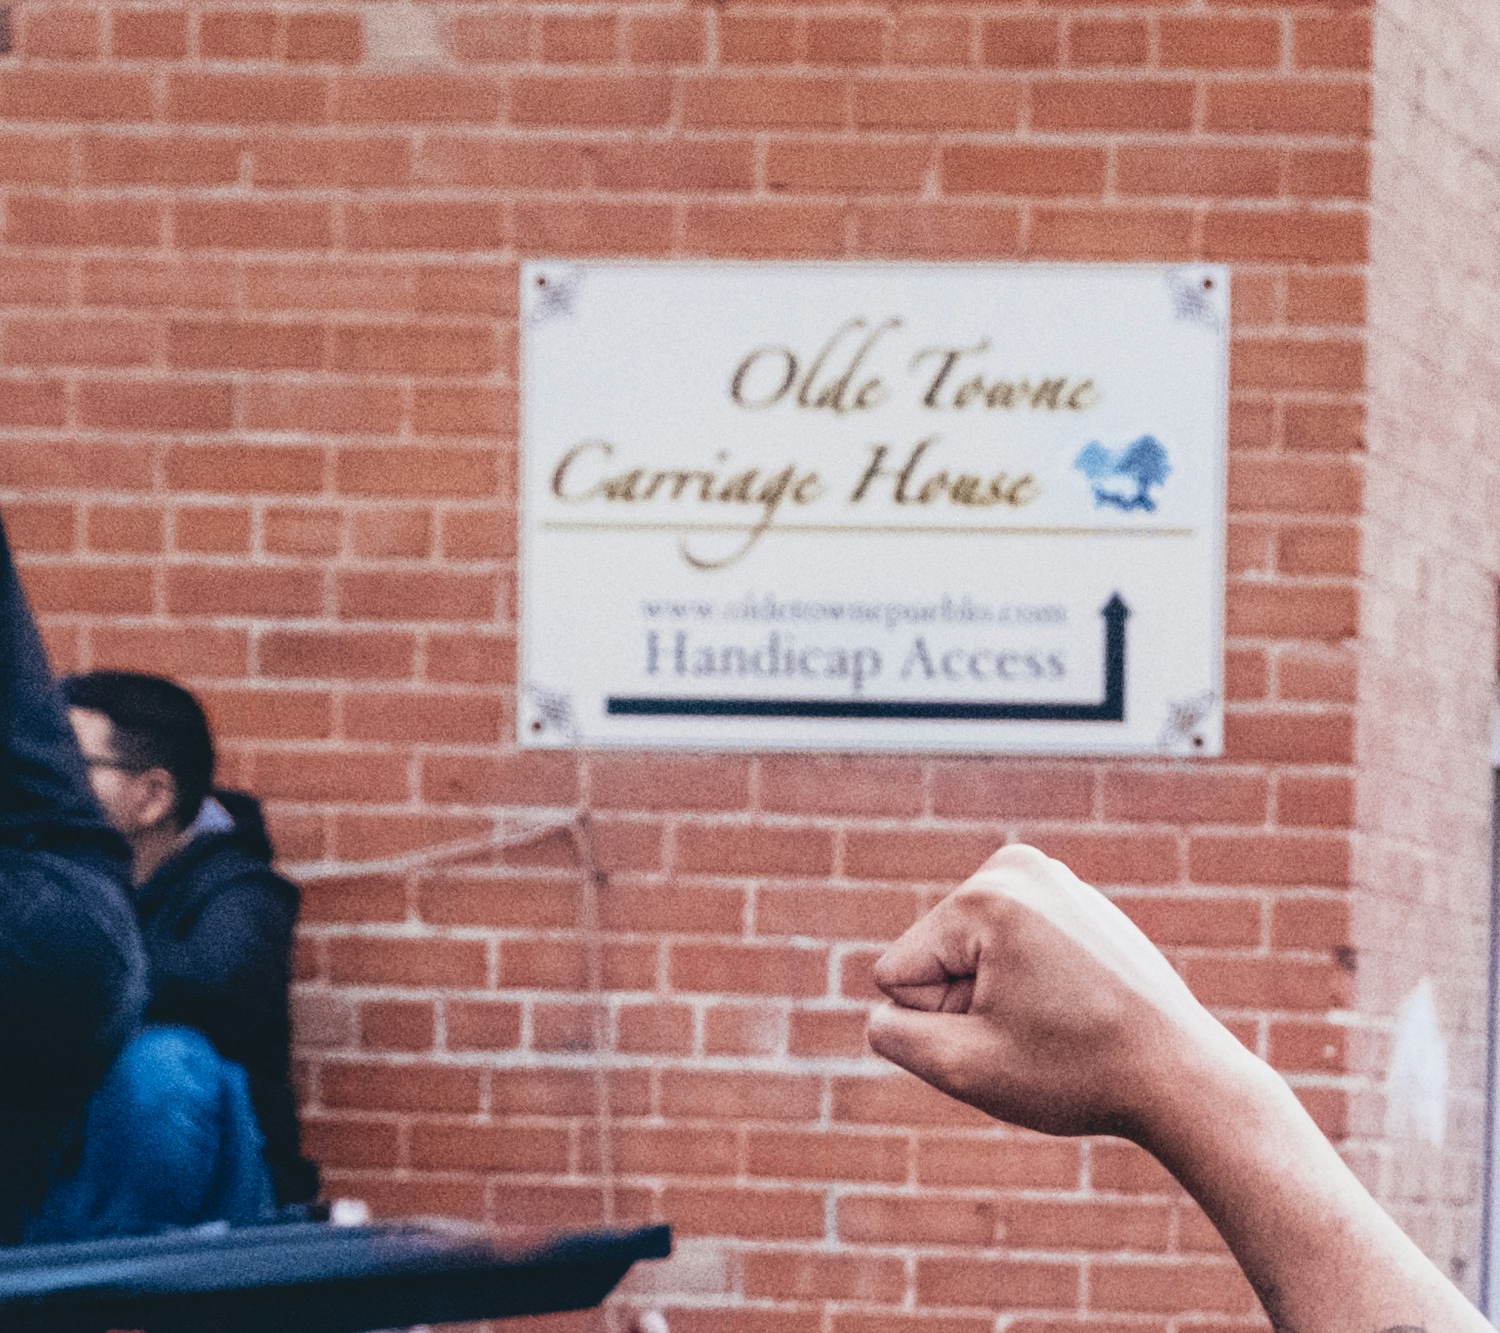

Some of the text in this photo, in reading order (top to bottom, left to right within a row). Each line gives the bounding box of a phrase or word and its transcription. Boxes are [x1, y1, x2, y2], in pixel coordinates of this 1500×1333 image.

[729, 317, 1099, 416] Olde Towne
[551, 433, 1042, 571] Carriage House
[644, 629, 1068, 694] Handicap Access
